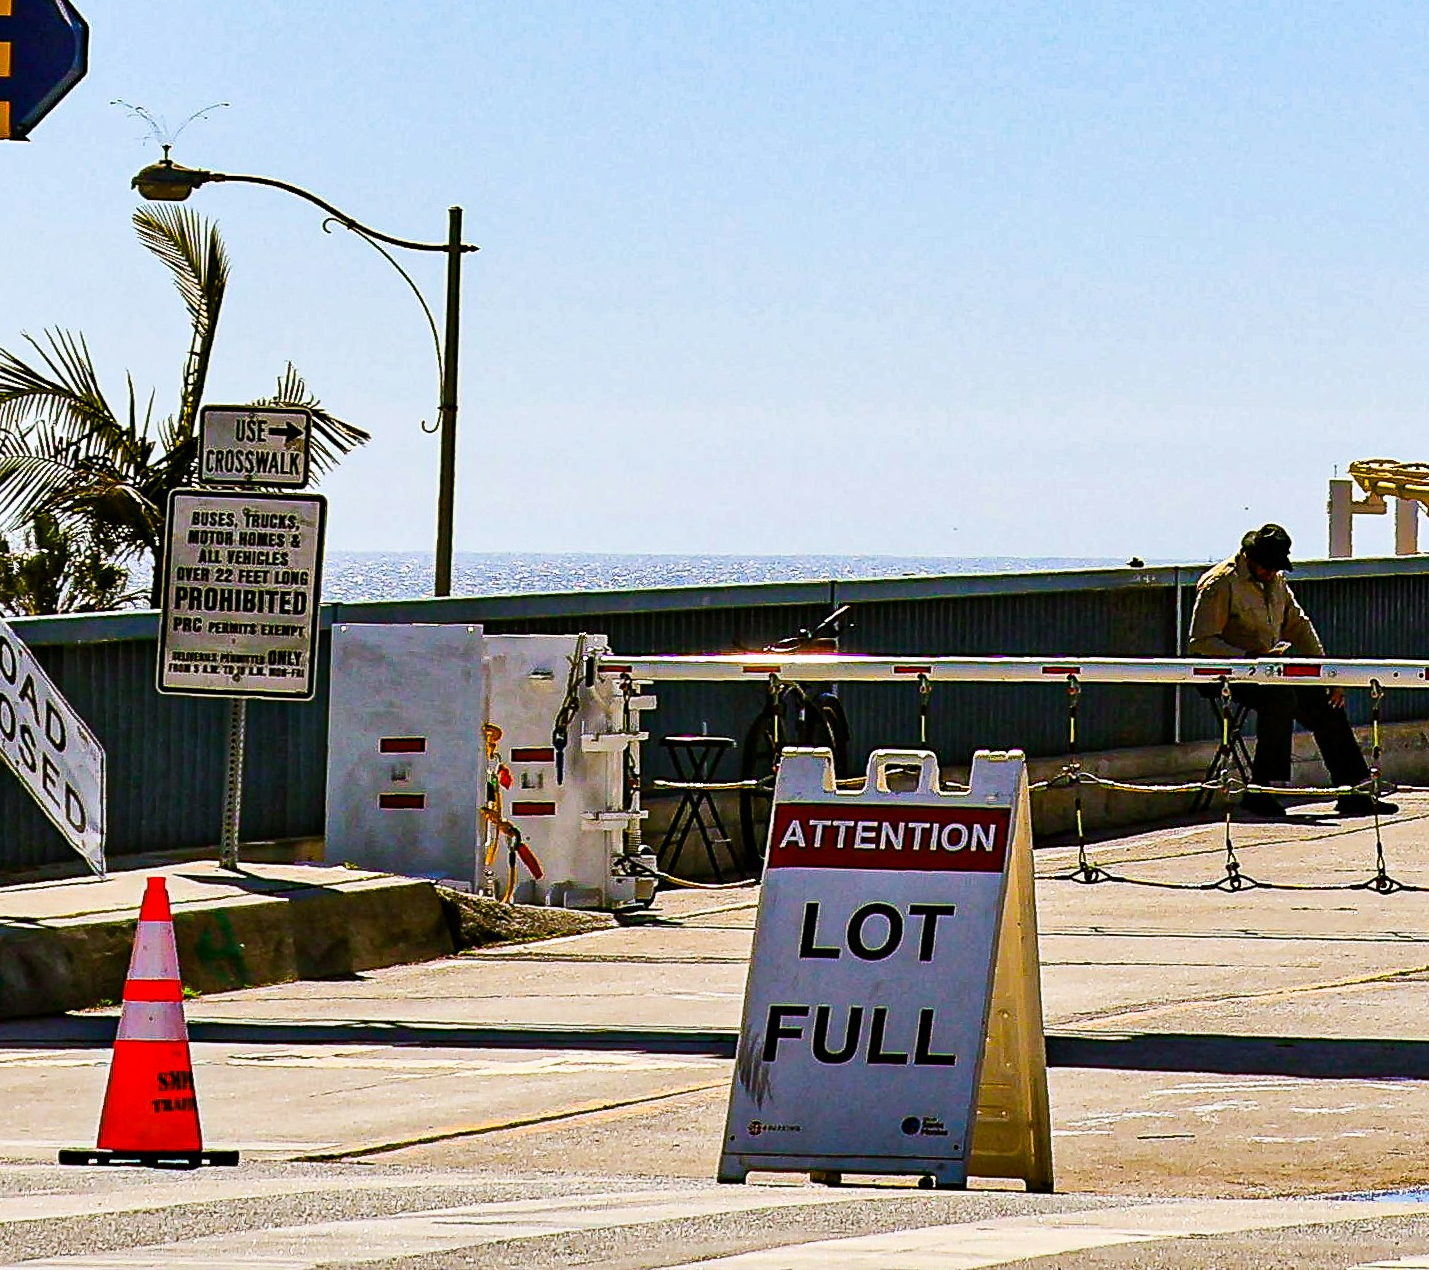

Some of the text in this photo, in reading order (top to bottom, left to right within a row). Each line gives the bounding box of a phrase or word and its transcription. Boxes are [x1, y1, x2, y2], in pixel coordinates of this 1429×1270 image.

[236, 419, 268, 442] USE
[205, 449, 300, 475] CROSSWALK
[191, 511, 300, 531] BUSES, TRUCKS,
[187, 530, 301, 548] MOTOR HOMES &
[198, 548, 289, 566] ALL VEHICLES
[176, 567, 308, 585] OVER 22 FEET LONG
[174, 586, 308, 615] PROHIBITED
[173, 617, 305, 638] PRC PERMITS EXEMPT
[268, 650, 302, 666] ONLY
[779, 817, 997, 853] ATTENTION
[799, 902, 957, 963] LOT
[764, 1004, 958, 1067] FULL
